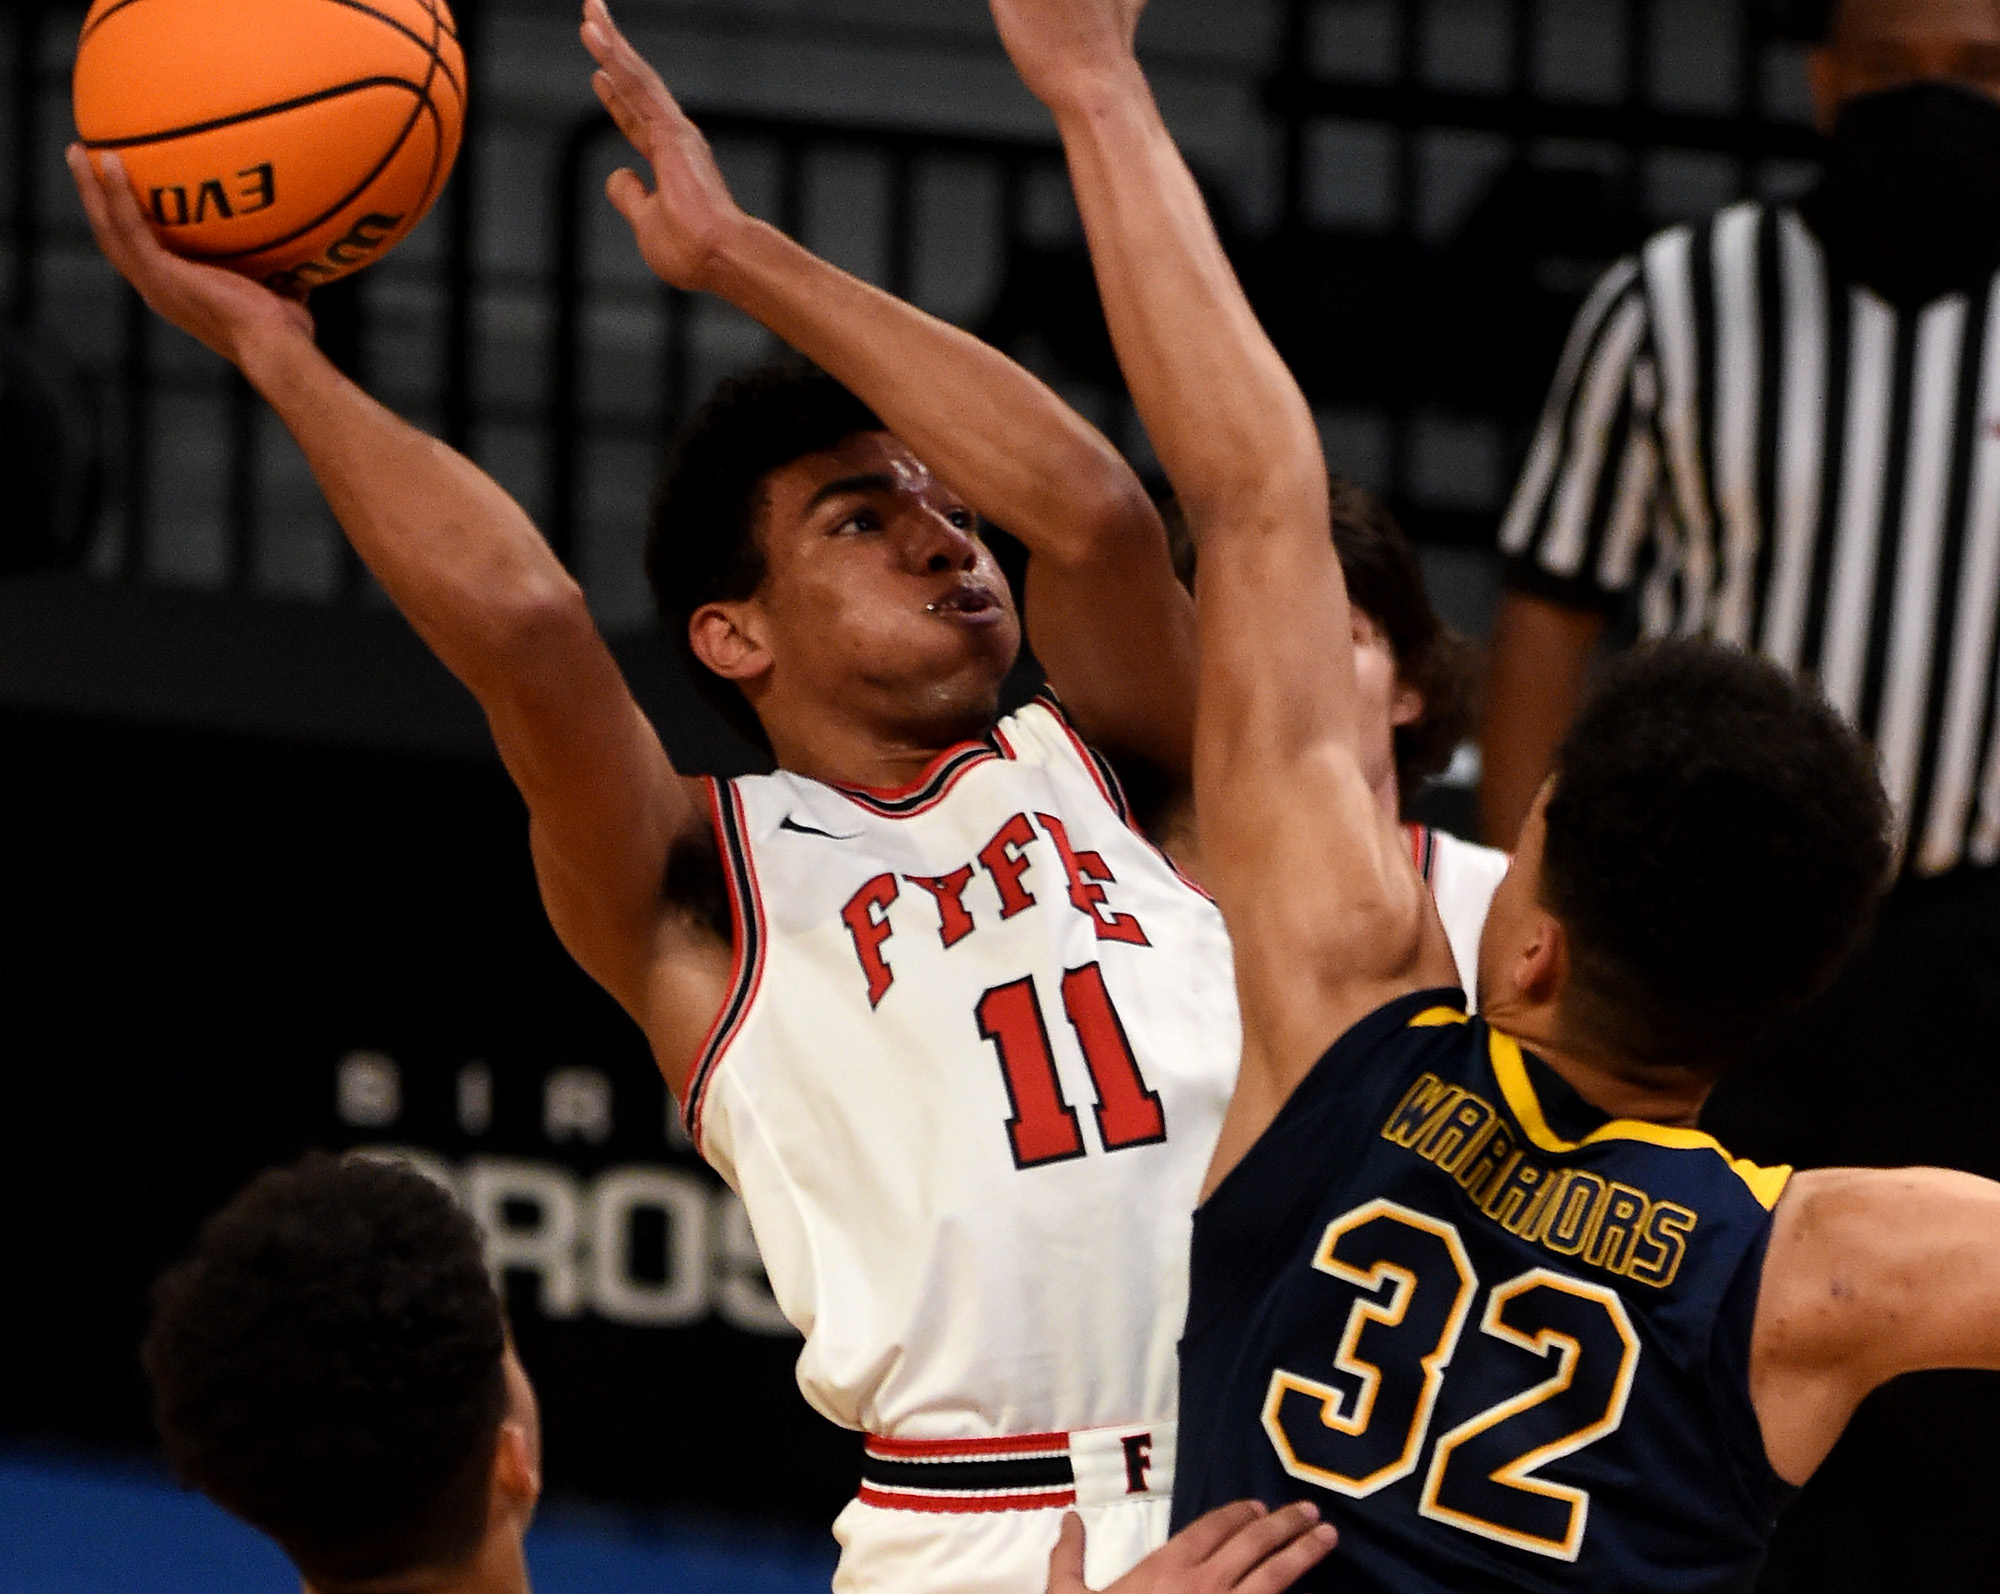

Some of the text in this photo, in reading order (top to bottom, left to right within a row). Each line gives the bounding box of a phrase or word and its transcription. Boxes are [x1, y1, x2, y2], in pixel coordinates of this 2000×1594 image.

[149, 161, 276, 228] EVO
[840, 810, 1153, 1011] FYFE
[336, 1049, 692, 1147] BIR
[974, 960, 1167, 1171] 11
[1380, 1071, 1698, 1289] WARRIORS
[1120, 1432, 1152, 1494] F
[1261, 1198, 1642, 1563] 32
